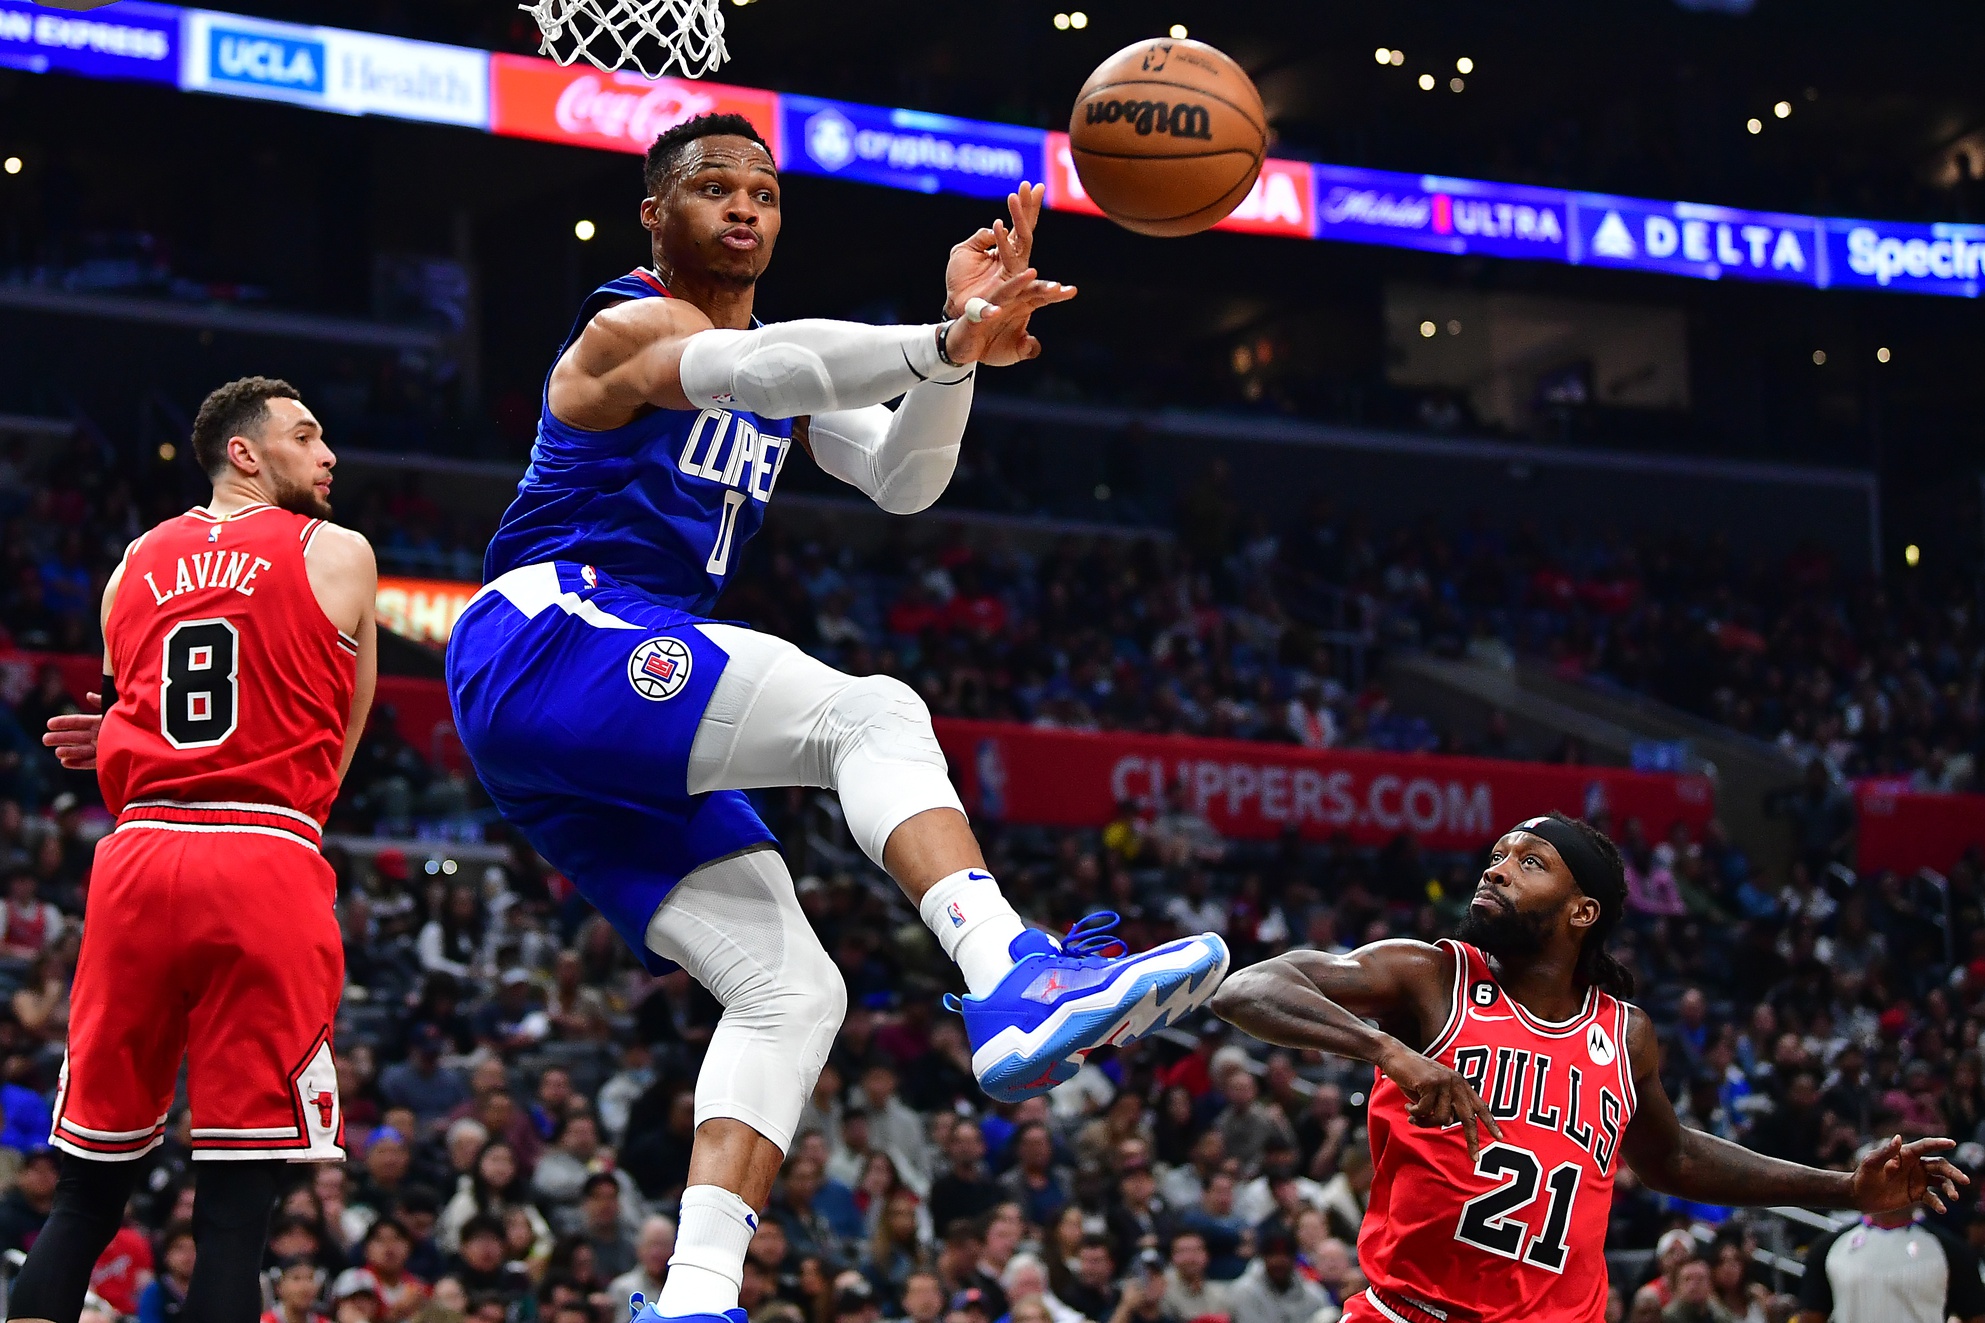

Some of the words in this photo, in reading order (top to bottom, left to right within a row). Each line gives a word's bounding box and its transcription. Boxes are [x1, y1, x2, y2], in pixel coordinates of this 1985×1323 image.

[34, 14, 169, 60] EXPRESS
[218, 35, 317, 86] UCLA
[341, 53, 473, 106] Health
[1085, 100, 1213, 141] Wilson
[854, 128, 1024, 180] crypto.com
[1452, 198, 1563, 244] ULTRA
[1643, 213, 1805, 272] DELTA
[1846, 226, 1985, 286] Spectr
[706, 489, 747, 576] 0
[143, 549, 272, 606] LAVINE
[160, 616, 240, 750] 8
[1474, 982, 1493, 1006] 6
[1441, 1044, 1622, 1177] BULLS
[1453, 1140, 1583, 1275] 21
